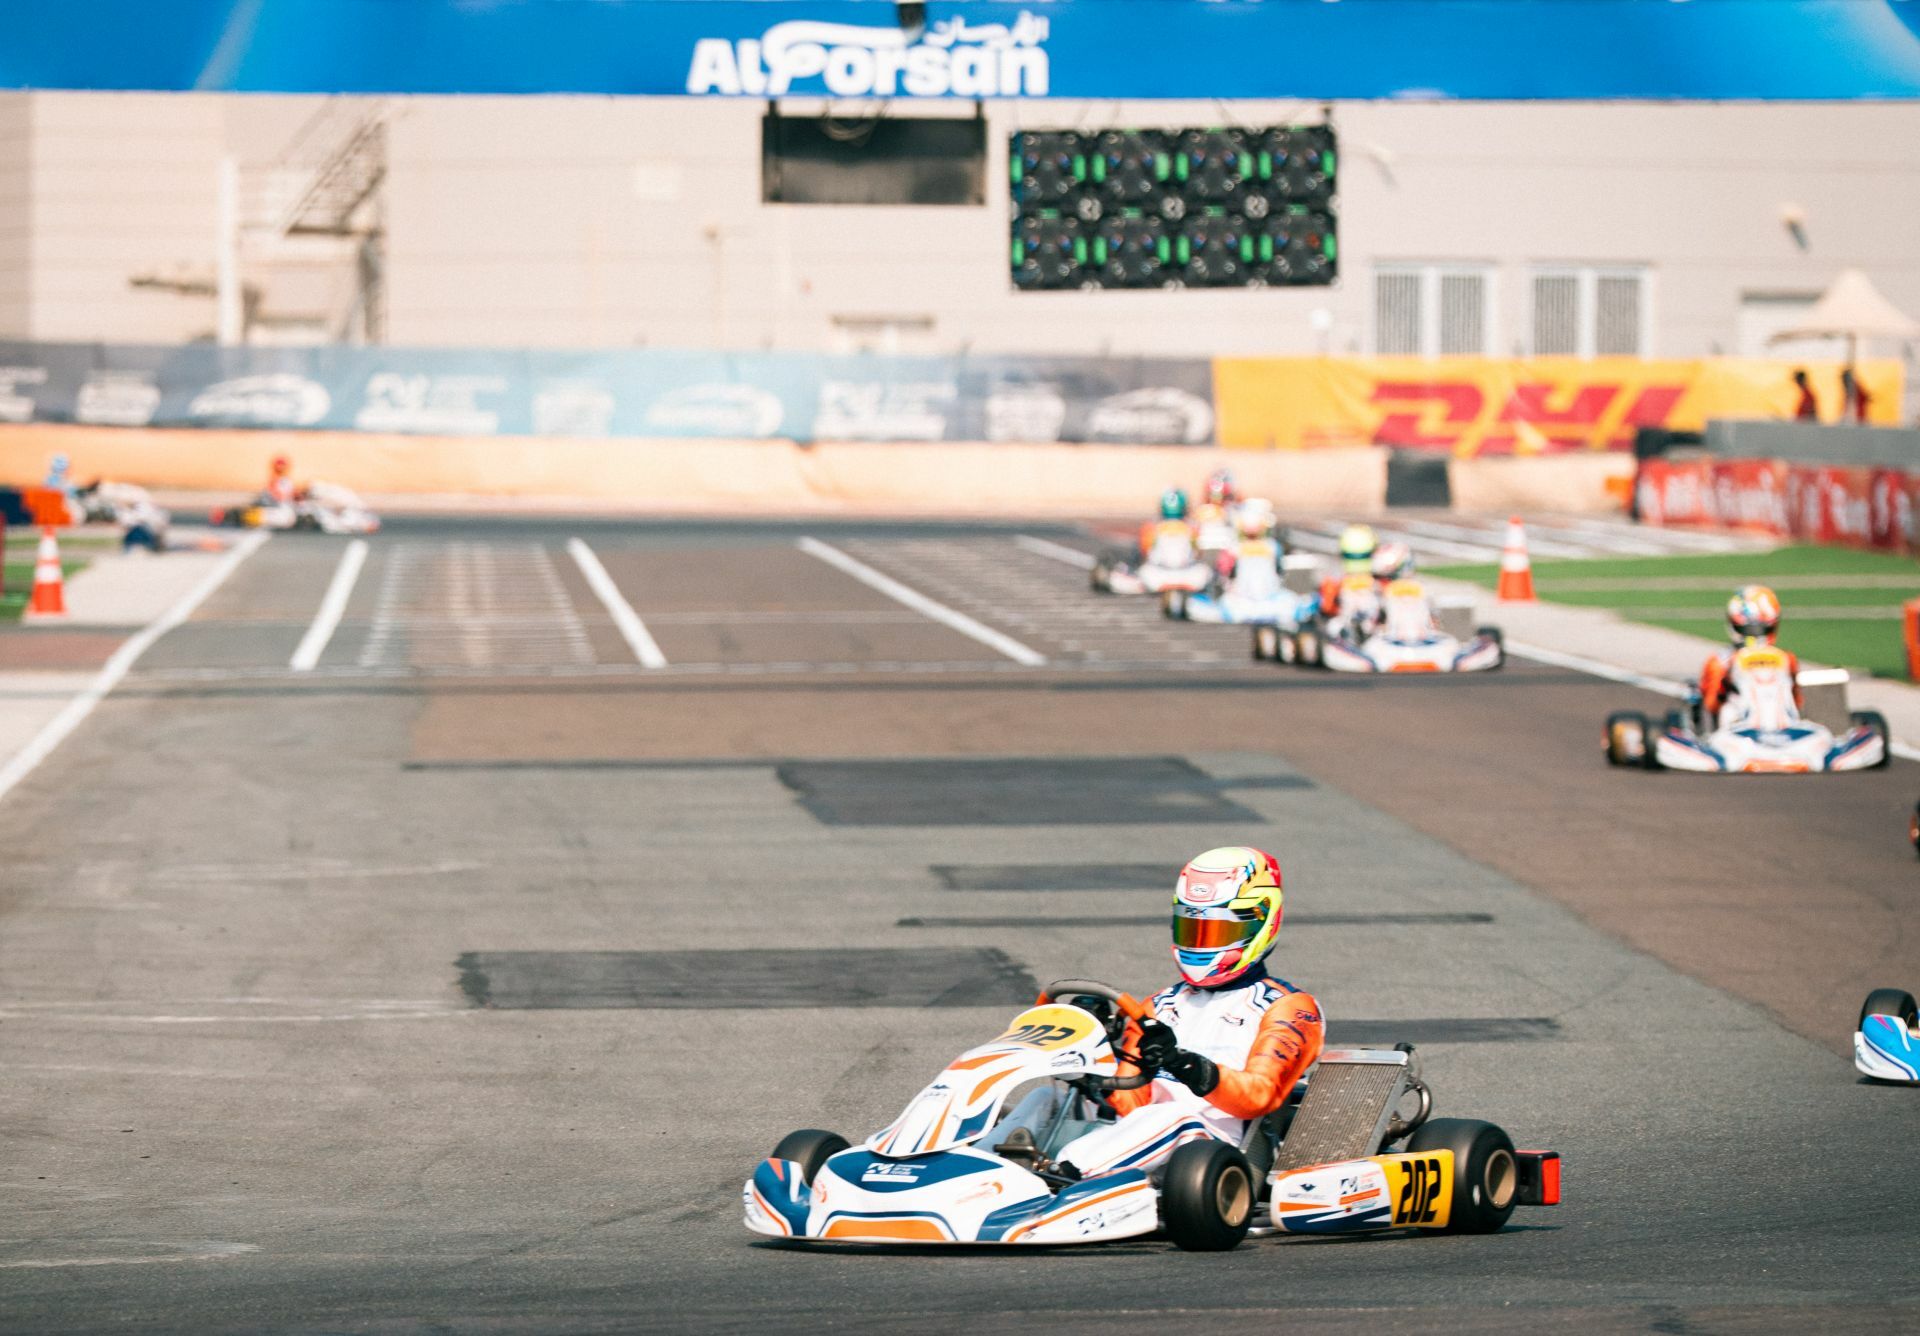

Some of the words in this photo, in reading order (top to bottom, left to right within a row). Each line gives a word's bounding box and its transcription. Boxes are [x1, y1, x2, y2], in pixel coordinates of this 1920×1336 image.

[1371, 382, 1690, 453] DHL
[1003, 1024, 1076, 1046] 202
[1395, 1159, 1442, 1224] 202
